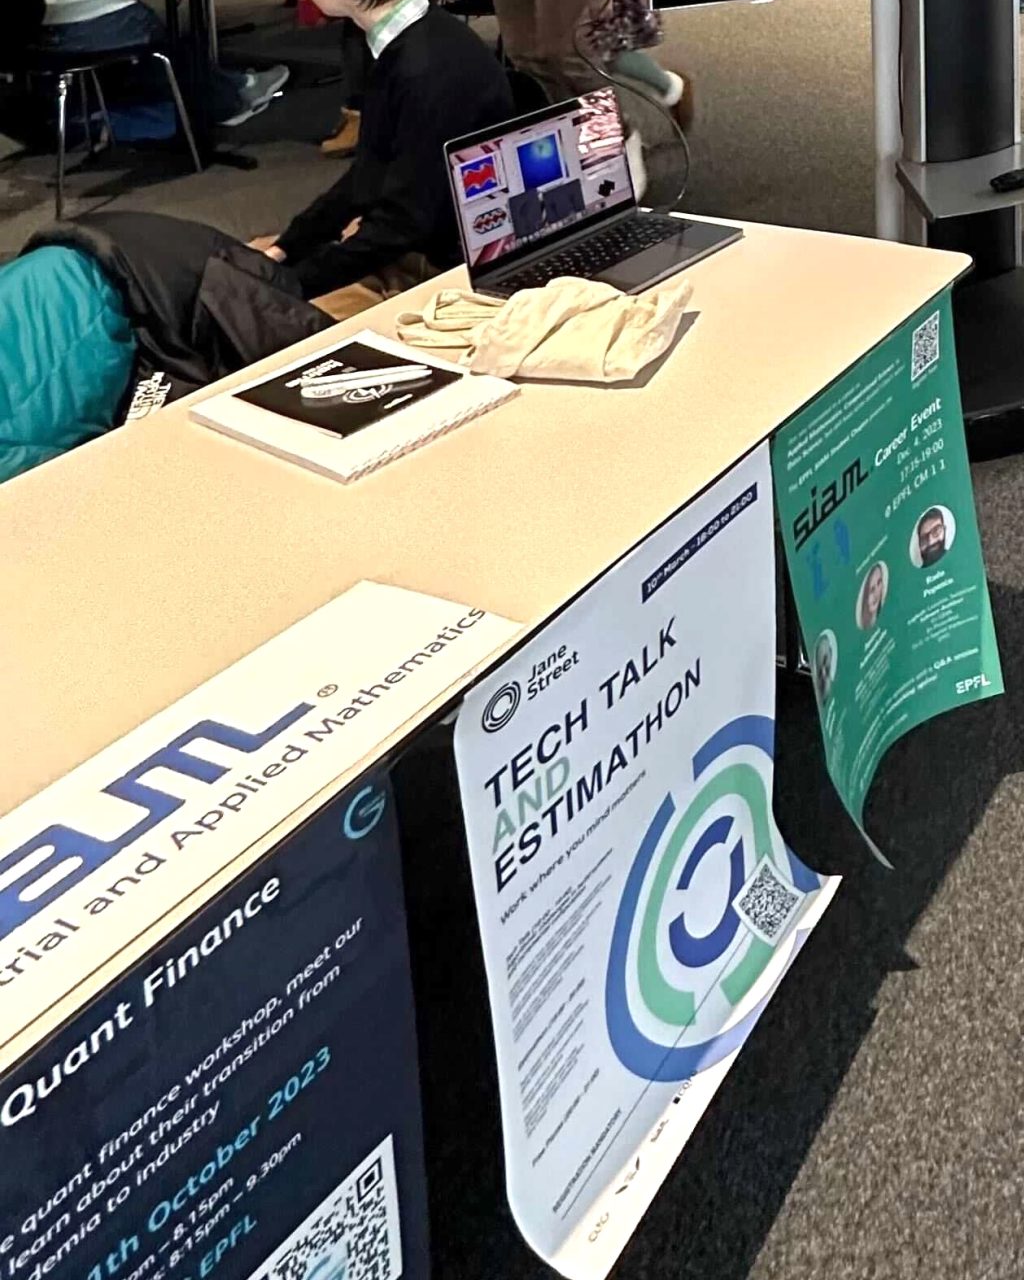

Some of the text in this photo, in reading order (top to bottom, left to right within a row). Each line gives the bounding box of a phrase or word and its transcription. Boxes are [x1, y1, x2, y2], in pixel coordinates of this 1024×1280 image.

[875, 428, 908, 467] Career
[911, 397, 942, 431] Event
[484, 615, 677, 809] TECH TALK
[526, 650, 580, 701] Street
[527, 644, 567, 684] Jane
[955, 673, 992, 694] EPFL
[83, 851, 167, 916] and
[170, 743, 309, 851] Applied
[303, 607, 486, 743] Mathematics
[492, 756, 570, 856] AND
[494, 656, 701, 894] ESTIMATHON
[500, 889, 528, 925] Work
[529, 854, 564, 893] where
[0, 876, 281, 1127] Quant Finance
[9, 965, 341, 1276] learn about their transition from
[21, 1162, 93, 1234] quant
[98, 1084, 181, 1165] finance
[185, 996, 283, 1086] workshop,
[286, 946, 332, 996] meet
[335, 917, 363, 950] our
[106, 1185, 131, 1213] to
[136, 1099, 220, 1187] industry
[147, 1115, 262, 1232] October
[268, 1046, 331, 1121] 2023
[200, 1214, 257, 1277] EPFL
